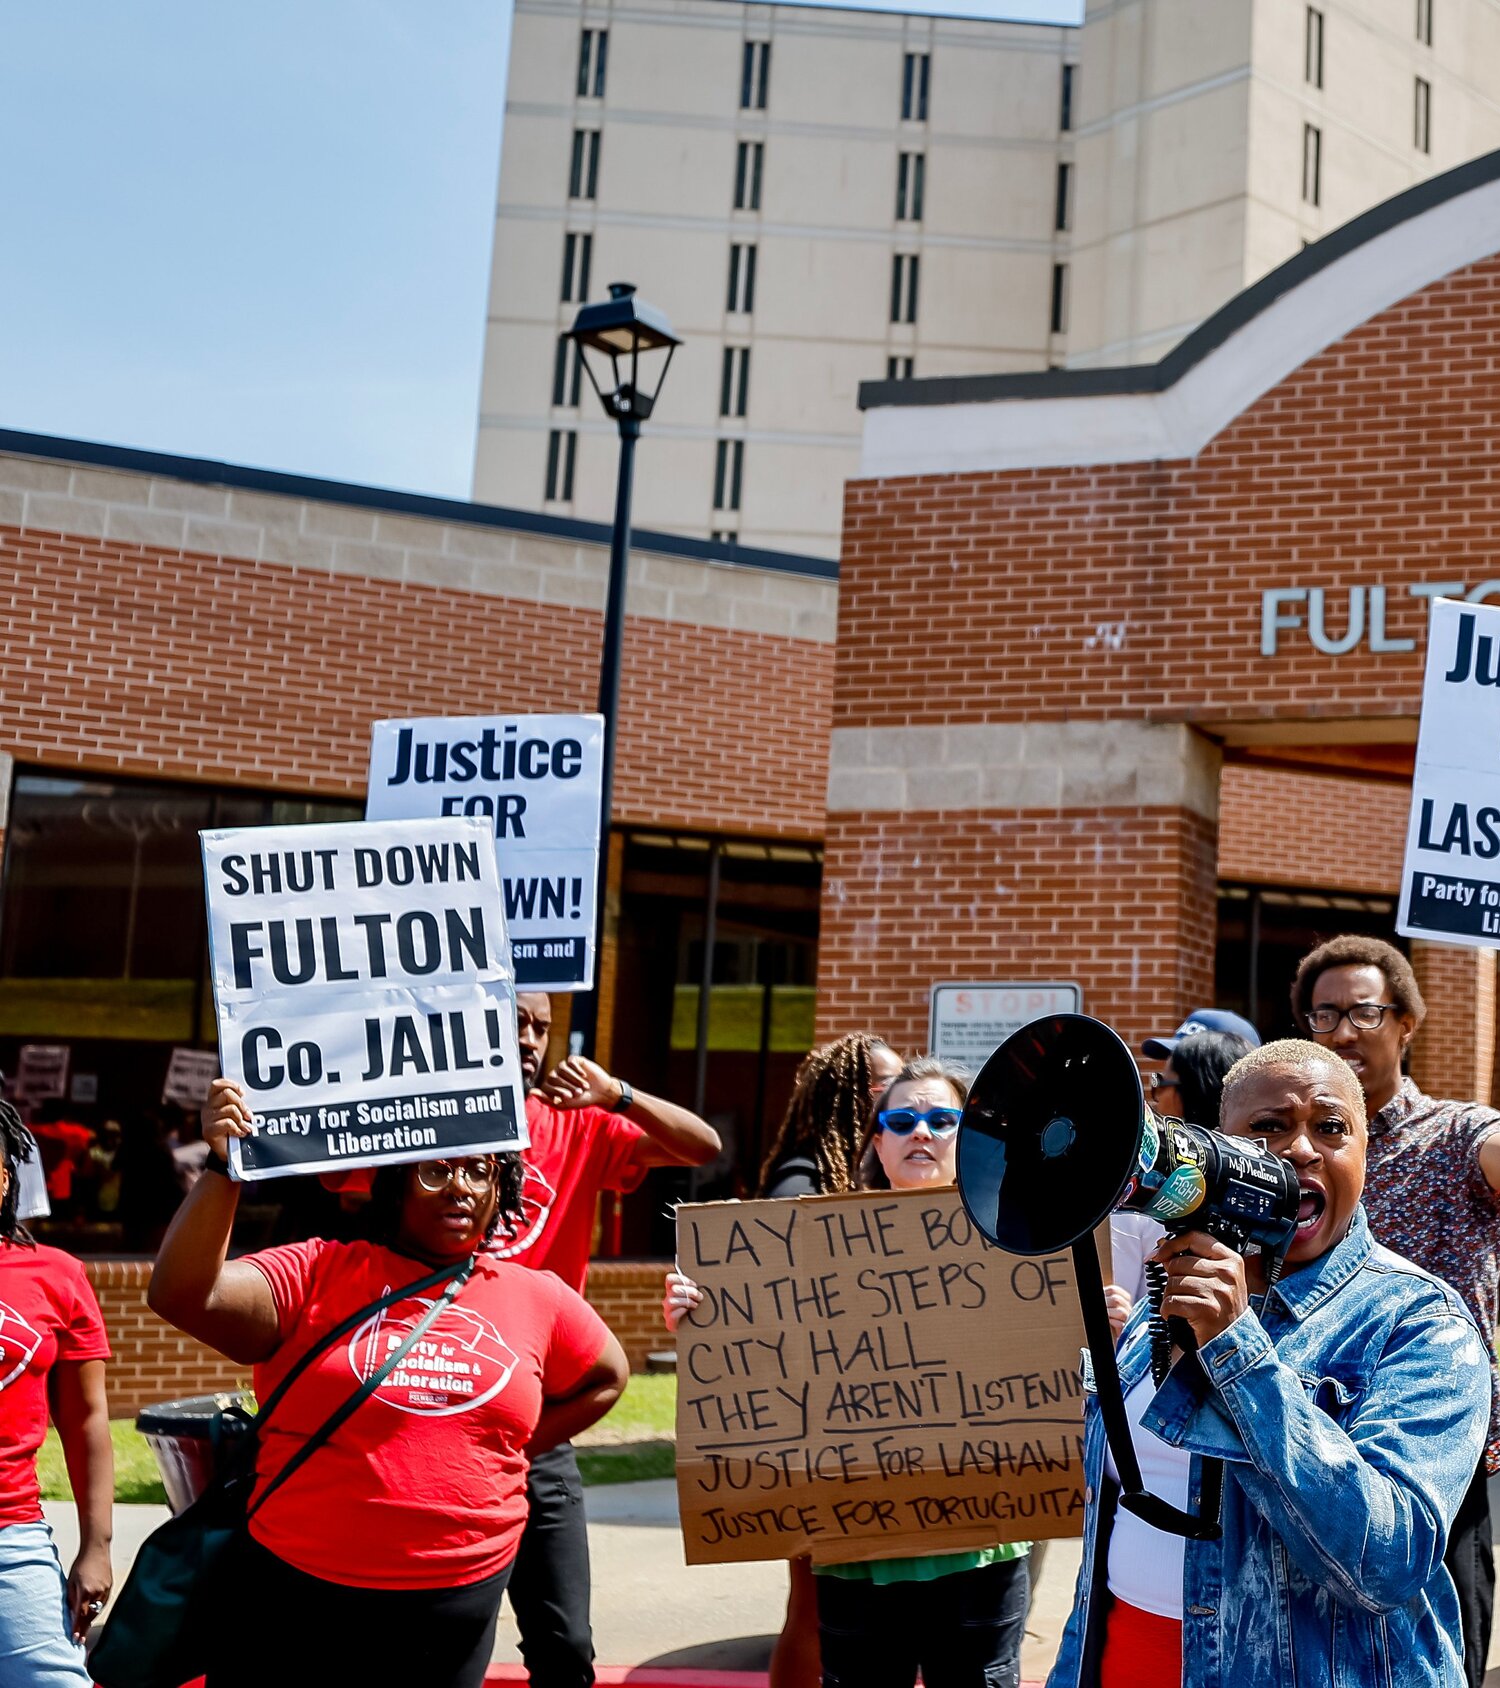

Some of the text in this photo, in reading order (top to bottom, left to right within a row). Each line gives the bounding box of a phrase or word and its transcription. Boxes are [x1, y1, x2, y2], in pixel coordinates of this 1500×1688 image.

[387, 725, 582, 786] Justice
[220, 841, 481, 896] SHUT DOWN
[1421, 876, 1475, 906] Party
[230, 906, 489, 990] FULTON
[543, 939, 575, 959] and
[241, 1026, 342, 1090] Co.
[361, 1009, 505, 1082] JAIL!
[252, 1089, 503, 1137] Party for Socialism and
[326, 1125, 437, 1156] Liberation
[1152, 1195, 1185, 1217] VOTE
[1170, 1174, 1203, 1203] FIGHT
[691, 1204, 995, 1268] LAY THE BO
[687, 1257, 1069, 1329] ON THE STEPS OF
[385, 1352, 470, 1375] ocialism
[387, 1334, 438, 1357] Prty
[688, 1321, 947, 1385] CITY HALL
[687, 1368, 1085, 1438] THEY AREN'T LISTENIN
[697, 1442, 868, 1493] JUSTICE
[873, 1436, 926, 1481] FOR
[700, 1487, 1085, 1545] JUSTICE FOR TORTUGUITA
